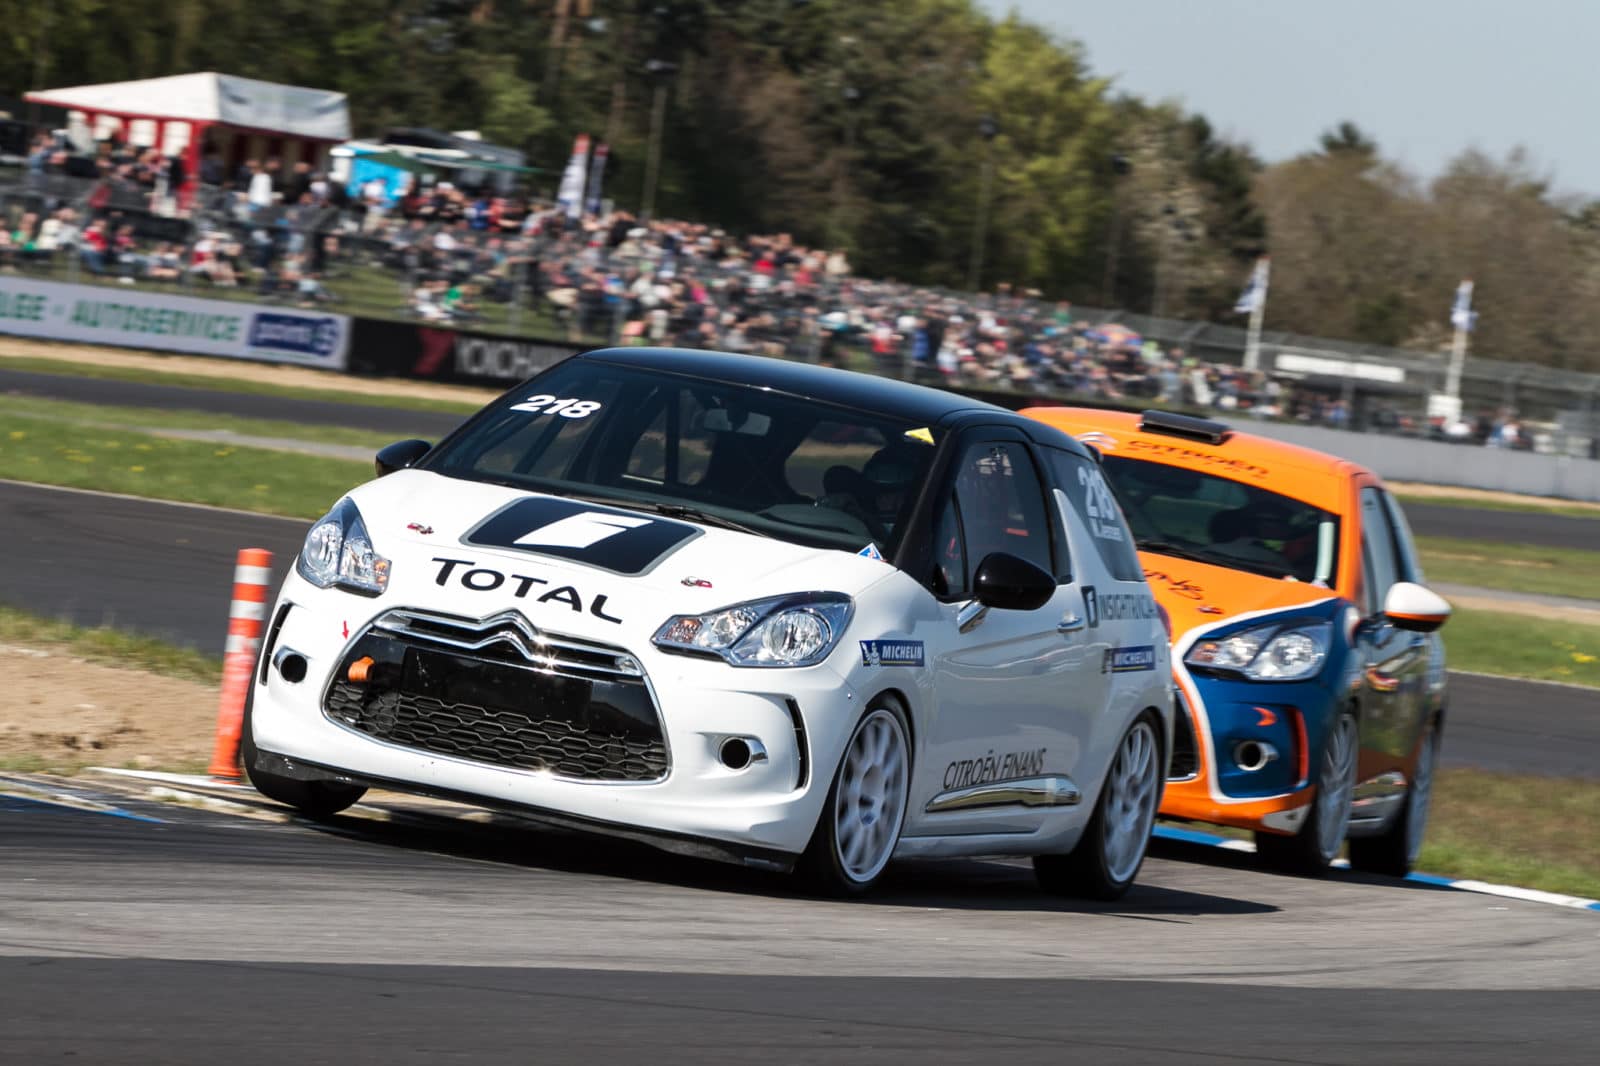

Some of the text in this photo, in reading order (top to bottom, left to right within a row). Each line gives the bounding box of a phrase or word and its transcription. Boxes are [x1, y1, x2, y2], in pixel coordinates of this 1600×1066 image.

[71, 299, 242, 342] AUTOSERVICE
[509, 394, 602, 418] 218
[431, 557, 623, 625] TOTAL
[881, 645, 923, 660] MICHELIN
[1113, 651, 1153, 667] MICHELIN
[943, 746, 1047, 791] CITROËN FINANS
